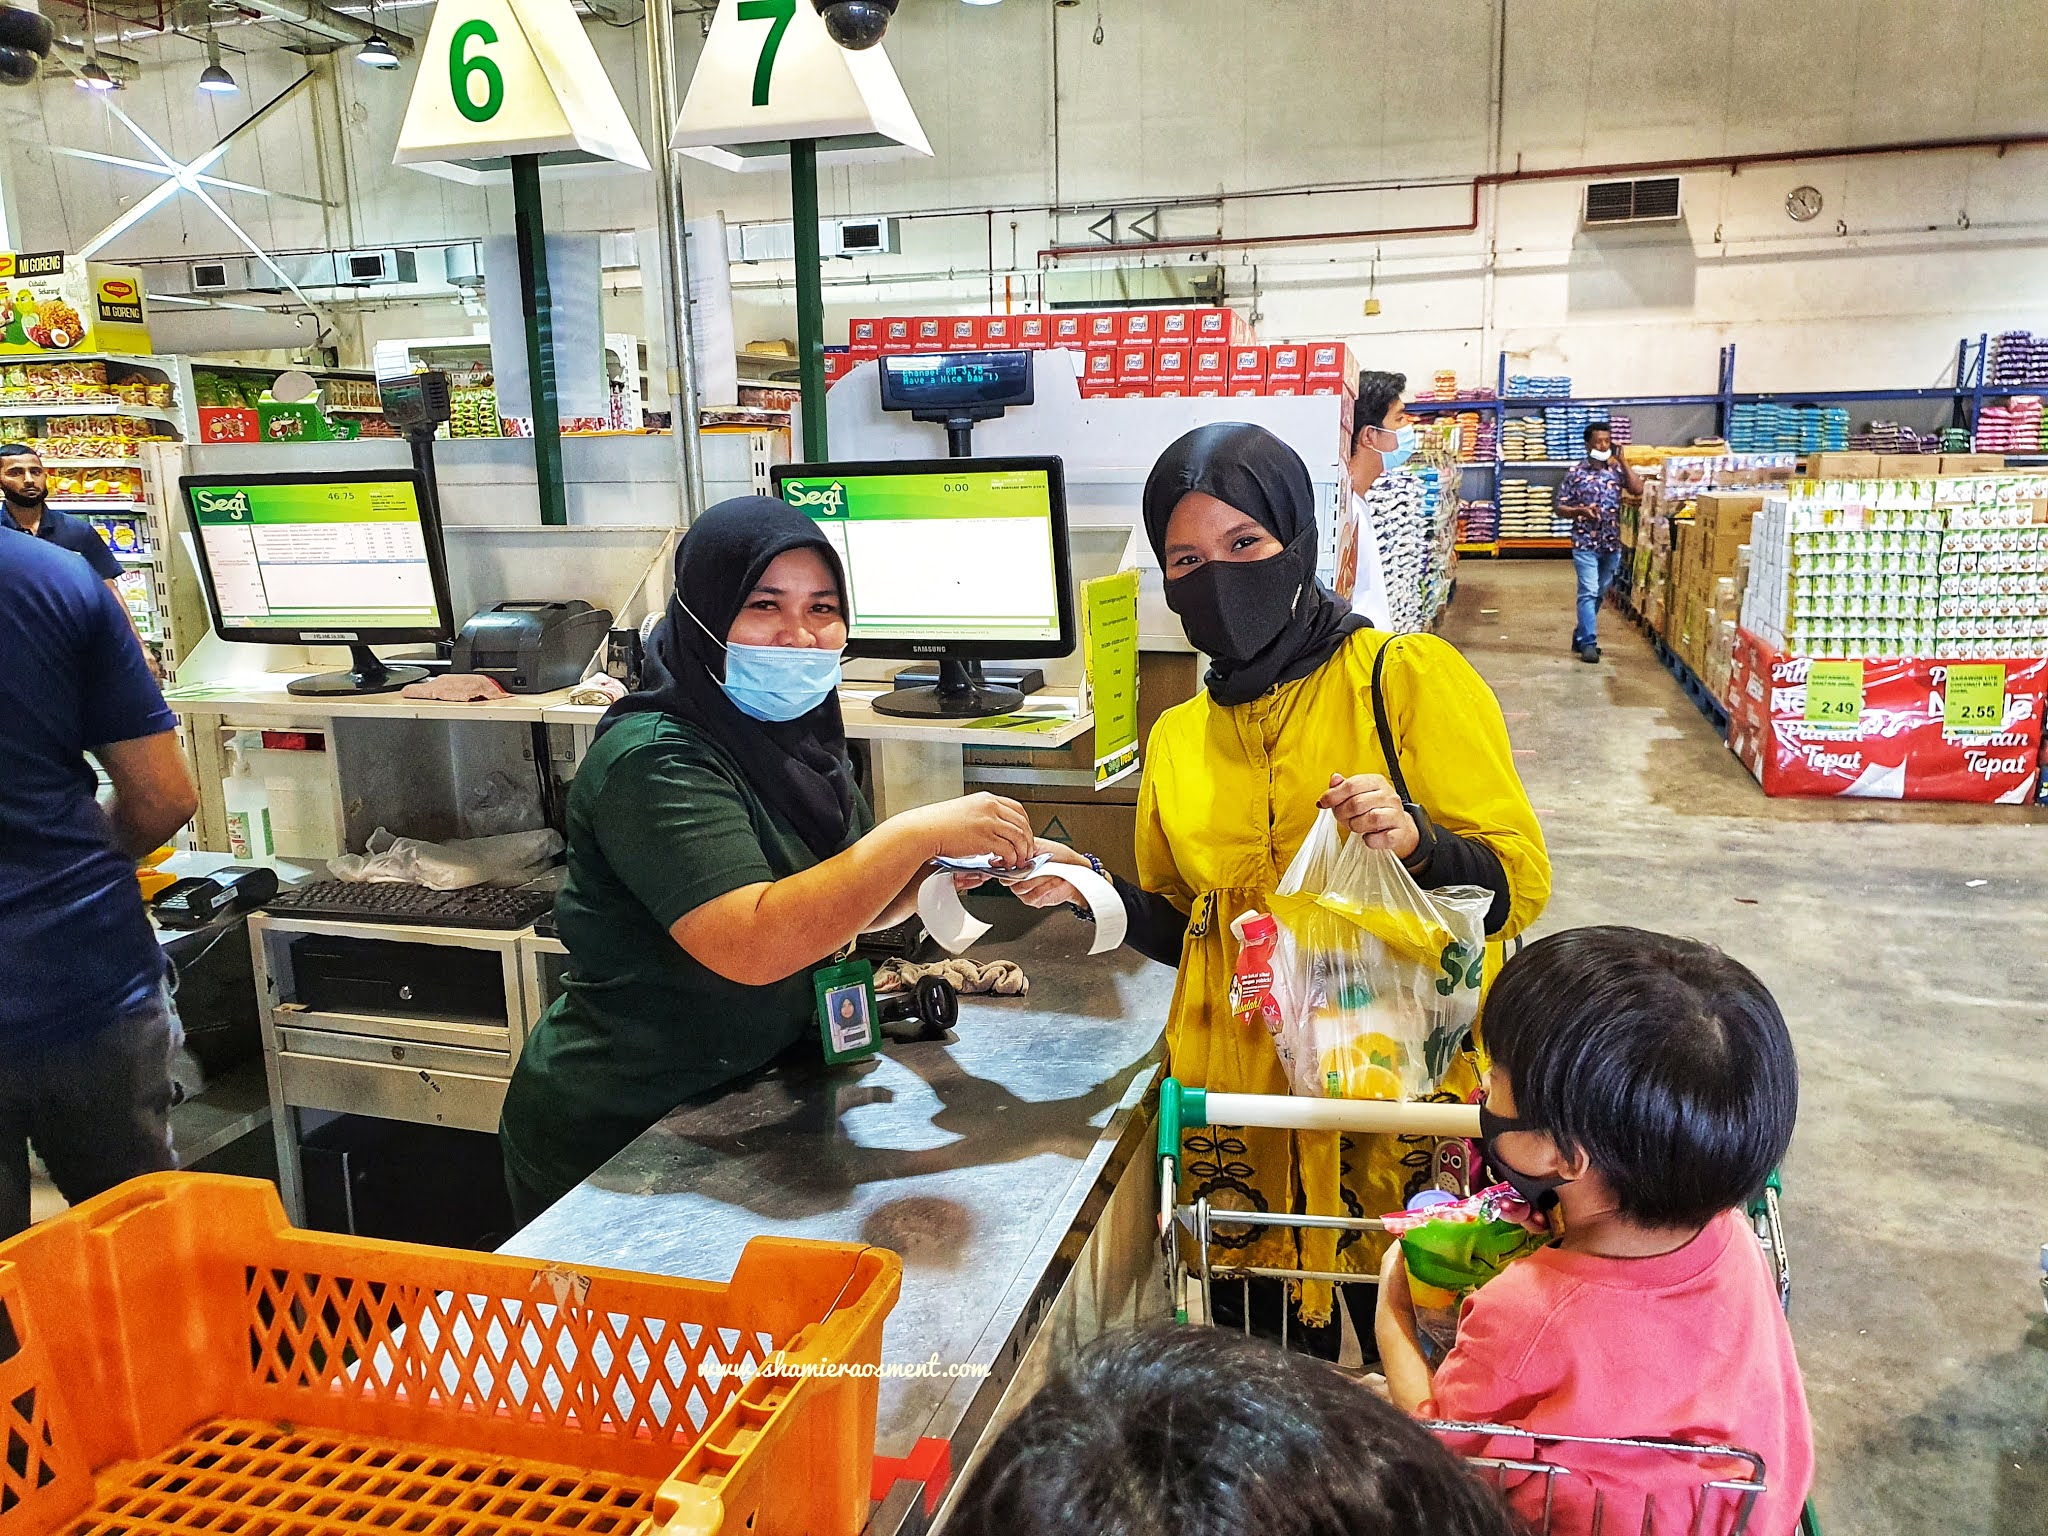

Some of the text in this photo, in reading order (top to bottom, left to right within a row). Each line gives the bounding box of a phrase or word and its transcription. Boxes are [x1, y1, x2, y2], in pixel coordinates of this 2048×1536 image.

[737, 1, 796, 107] 7
[449, 19, 504, 123] 6
[19, 258, 29, 274] MI
[29, 255, 61, 272] GORENG
[101, 305, 140, 319] MI GORENG
[946, 367, 957, 375] RM
[962, 365, 984, 375] 3.75
[903, 376, 925, 385] Have
[941, 375, 962, 383] Nice
[967, 373, 984, 382] Day
[943, 483, 969, 492] 0.00
[327, 492, 355, 501] 46.75
[786, 480, 844, 515] Segi
[197, 489, 249, 520] Segi
[912, 645, 946, 653] SAMSUNG
[1821, 701, 1854, 715] 2.49
[1961, 705, 1995, 718] 2.55
[1801, 744, 1863, 776] Tepat
[1964, 749, 2027, 782] Tepat
